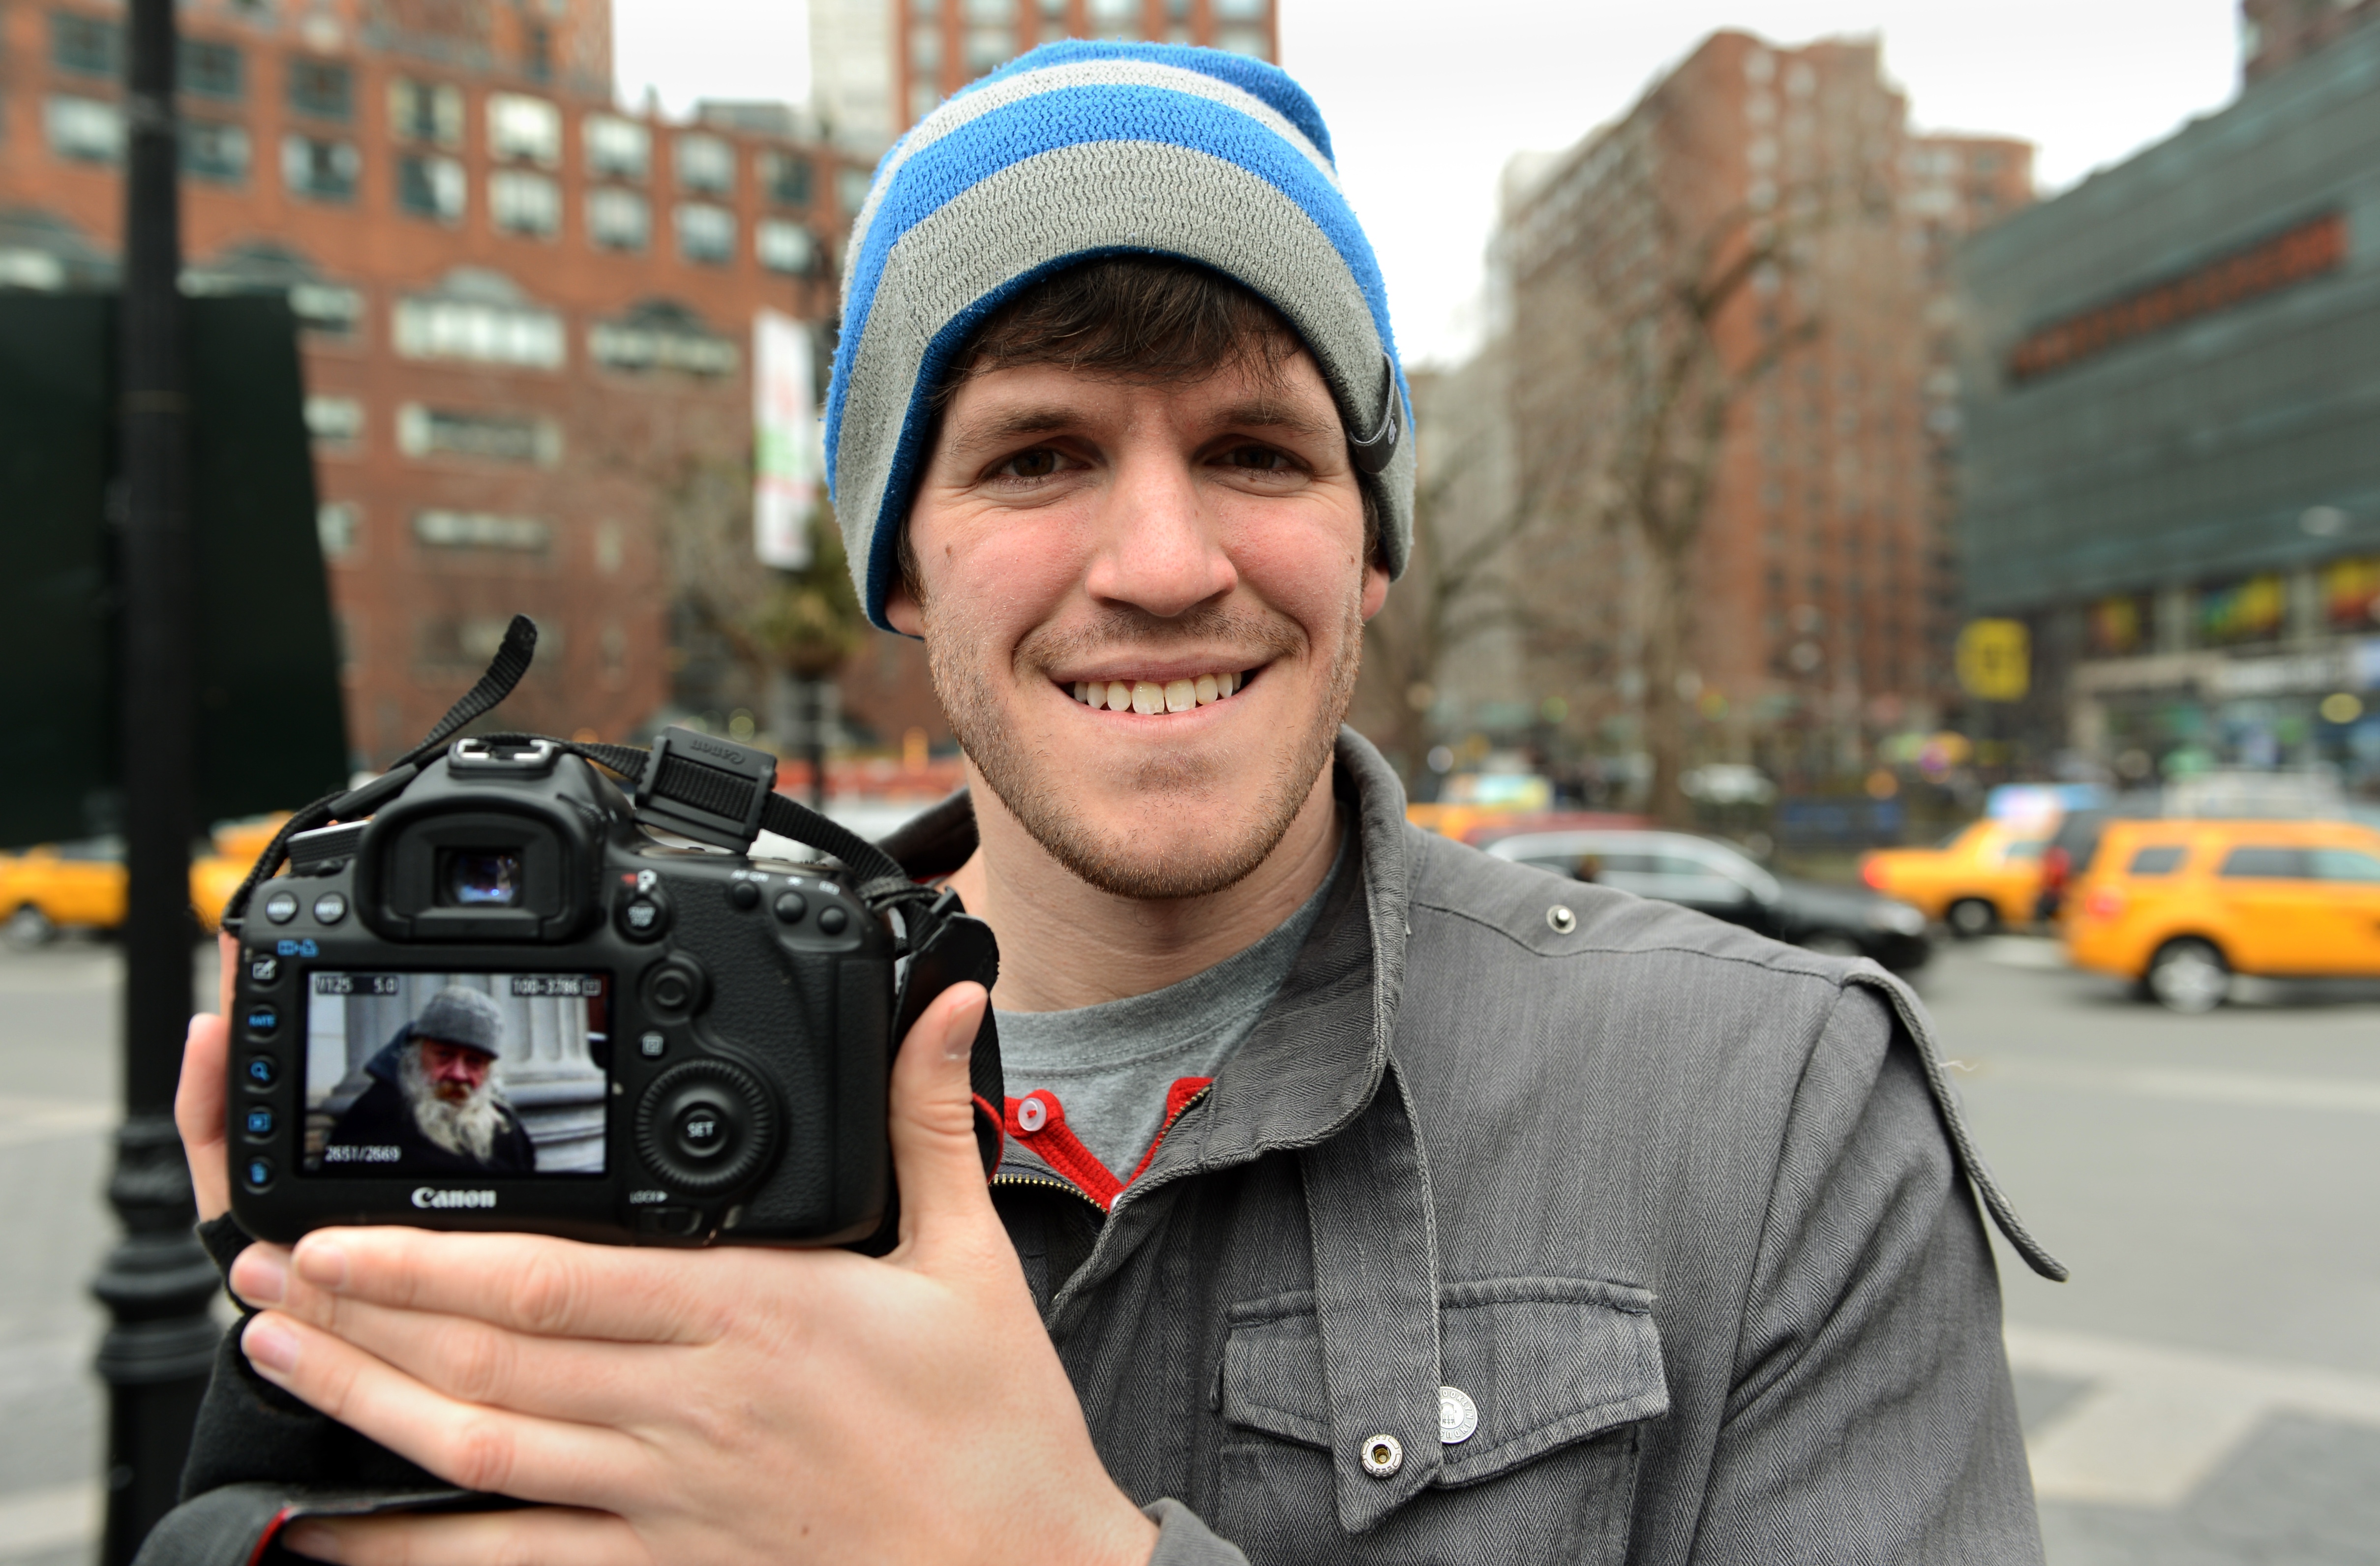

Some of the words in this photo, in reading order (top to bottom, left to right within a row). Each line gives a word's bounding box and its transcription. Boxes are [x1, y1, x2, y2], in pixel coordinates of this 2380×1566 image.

[690, 739, 746, 765] Canon
[267, 902, 297, 915] MENU
[248, 1014, 277, 1028] RATE
[687, 1121, 716, 1138] SET
[411, 1186, 497, 1208] Canon
[1442, 1390, 1474, 1420] OOKLYN
[1440, 1422, 1471, 1439] INDUS
